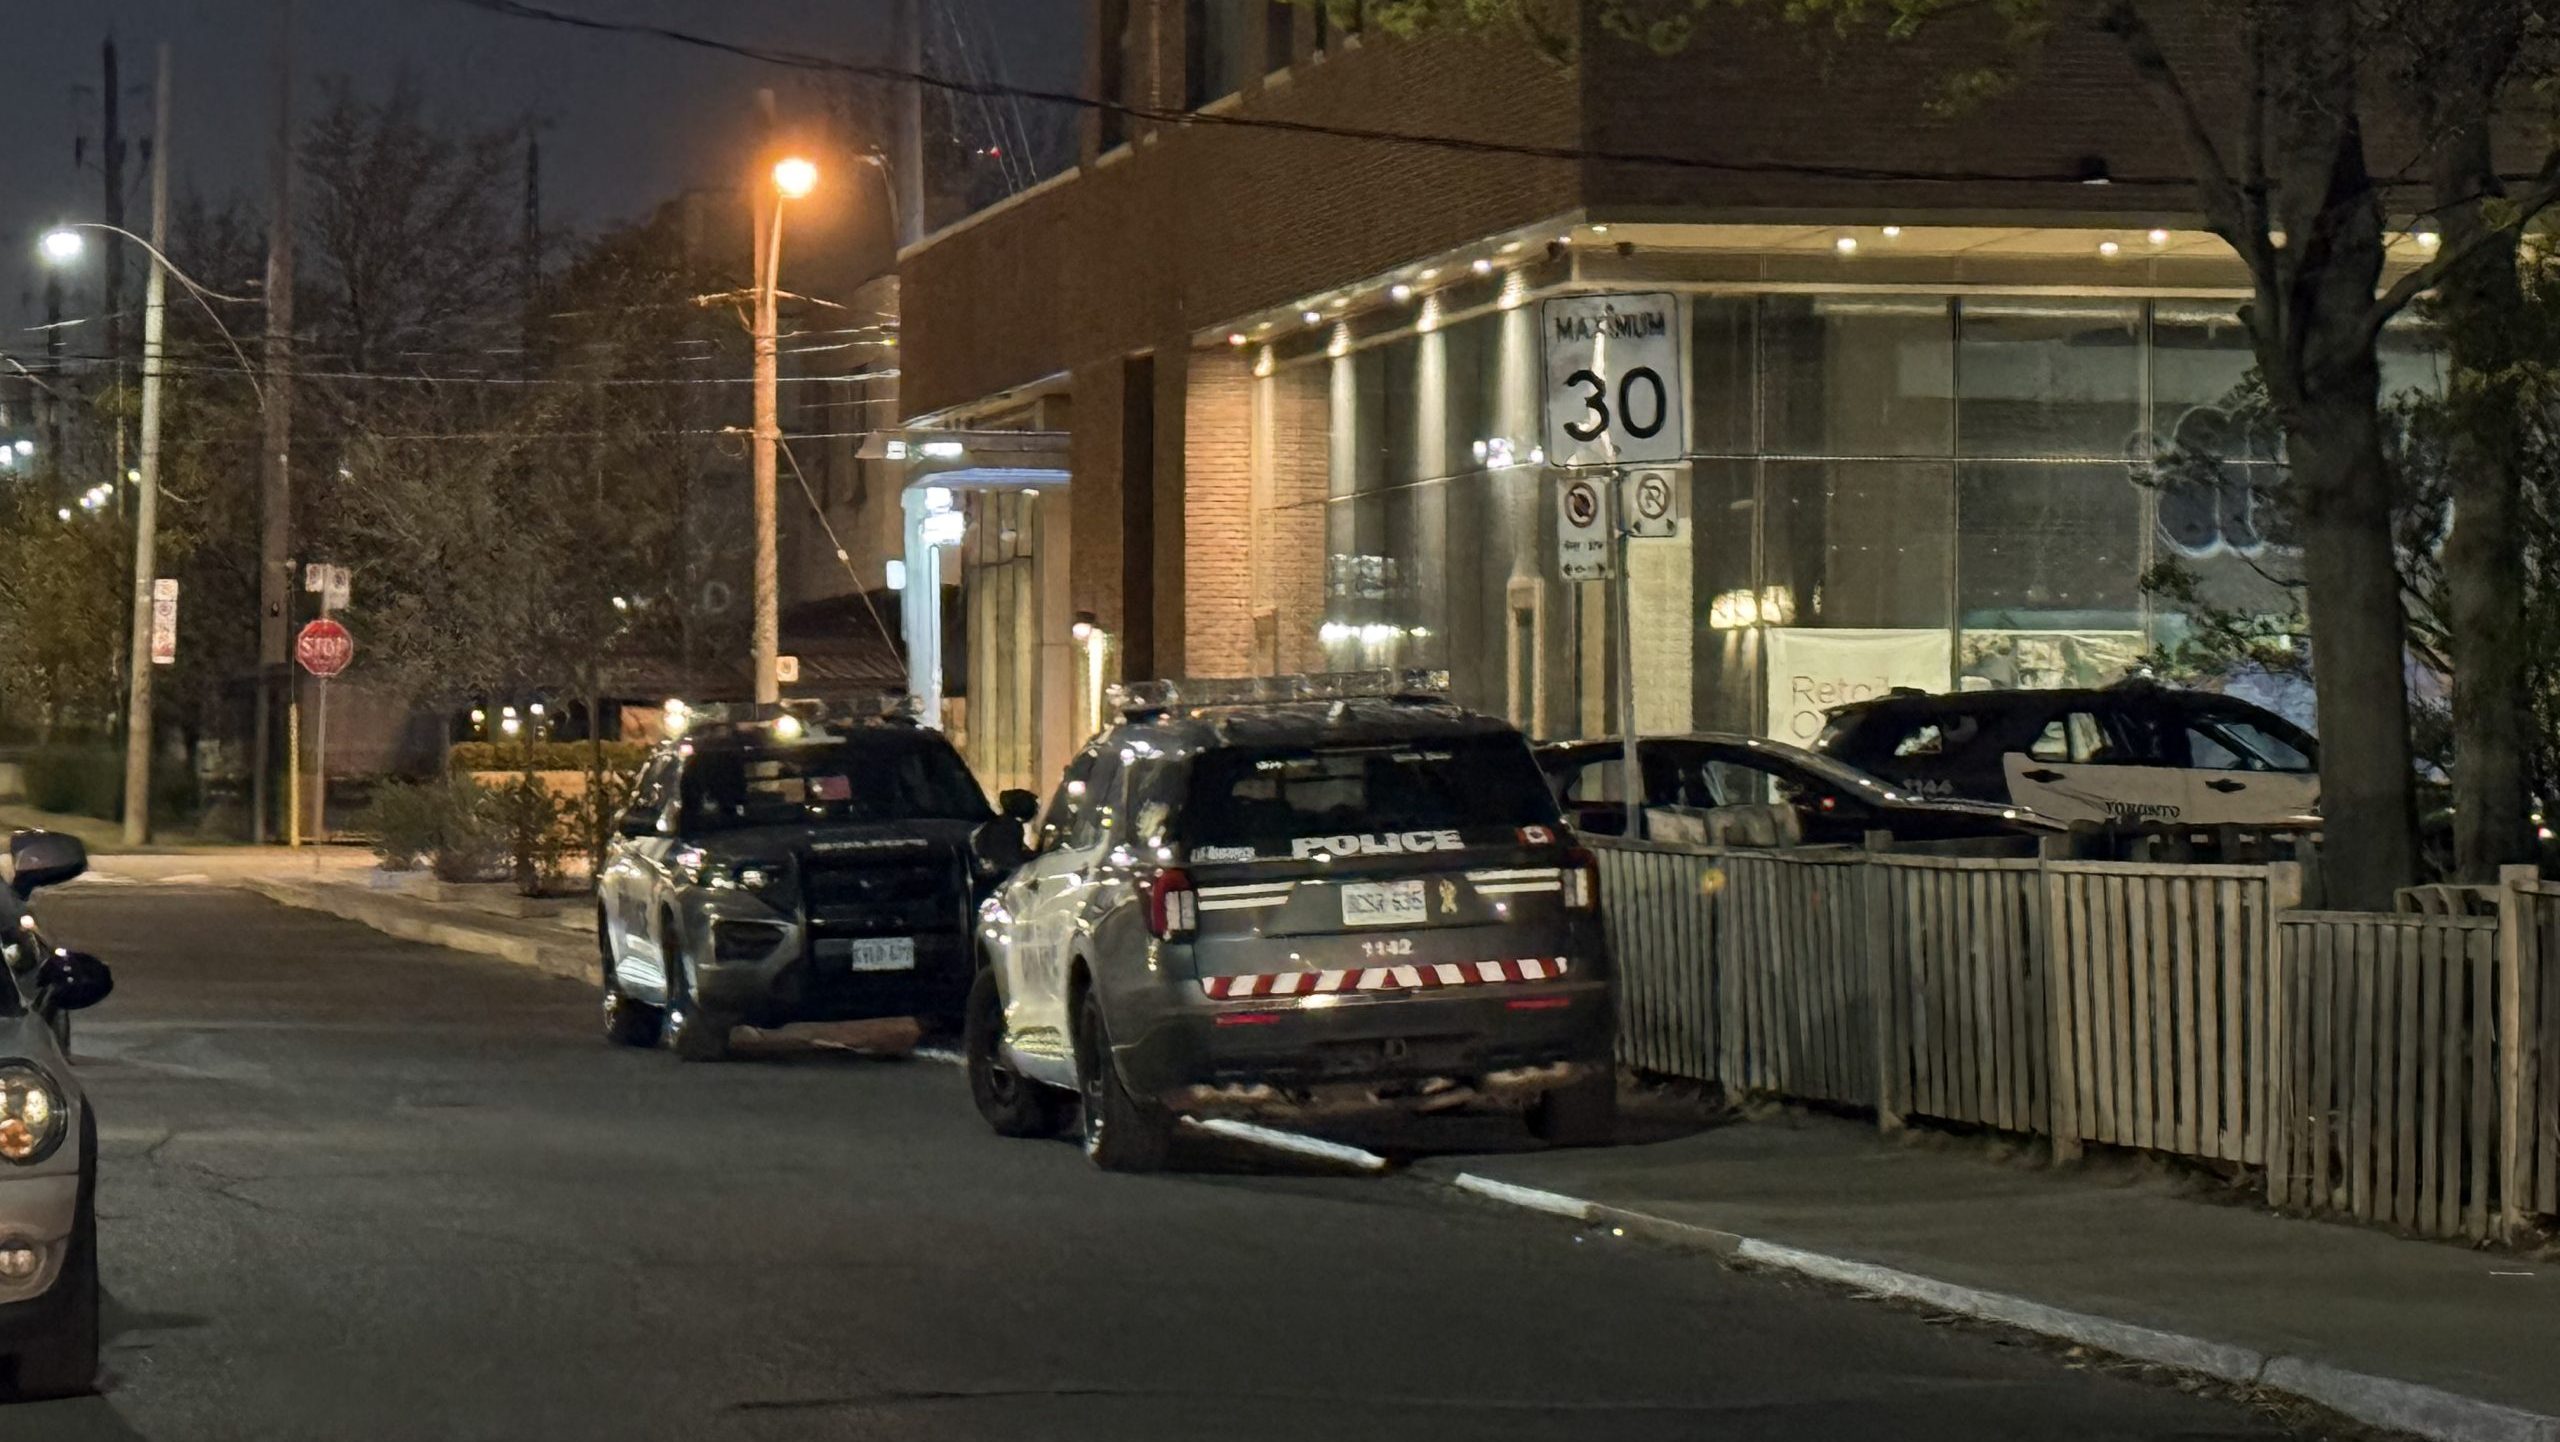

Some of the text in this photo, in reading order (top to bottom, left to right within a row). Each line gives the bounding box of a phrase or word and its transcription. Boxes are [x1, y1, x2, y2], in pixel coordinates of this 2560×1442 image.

[1555, 312, 1667, 342] MAXIMUM
[1563, 367, 1666, 442] 30
[301, 636, 350, 656] STOP
[1292, 830, 1465, 860] POLICE
